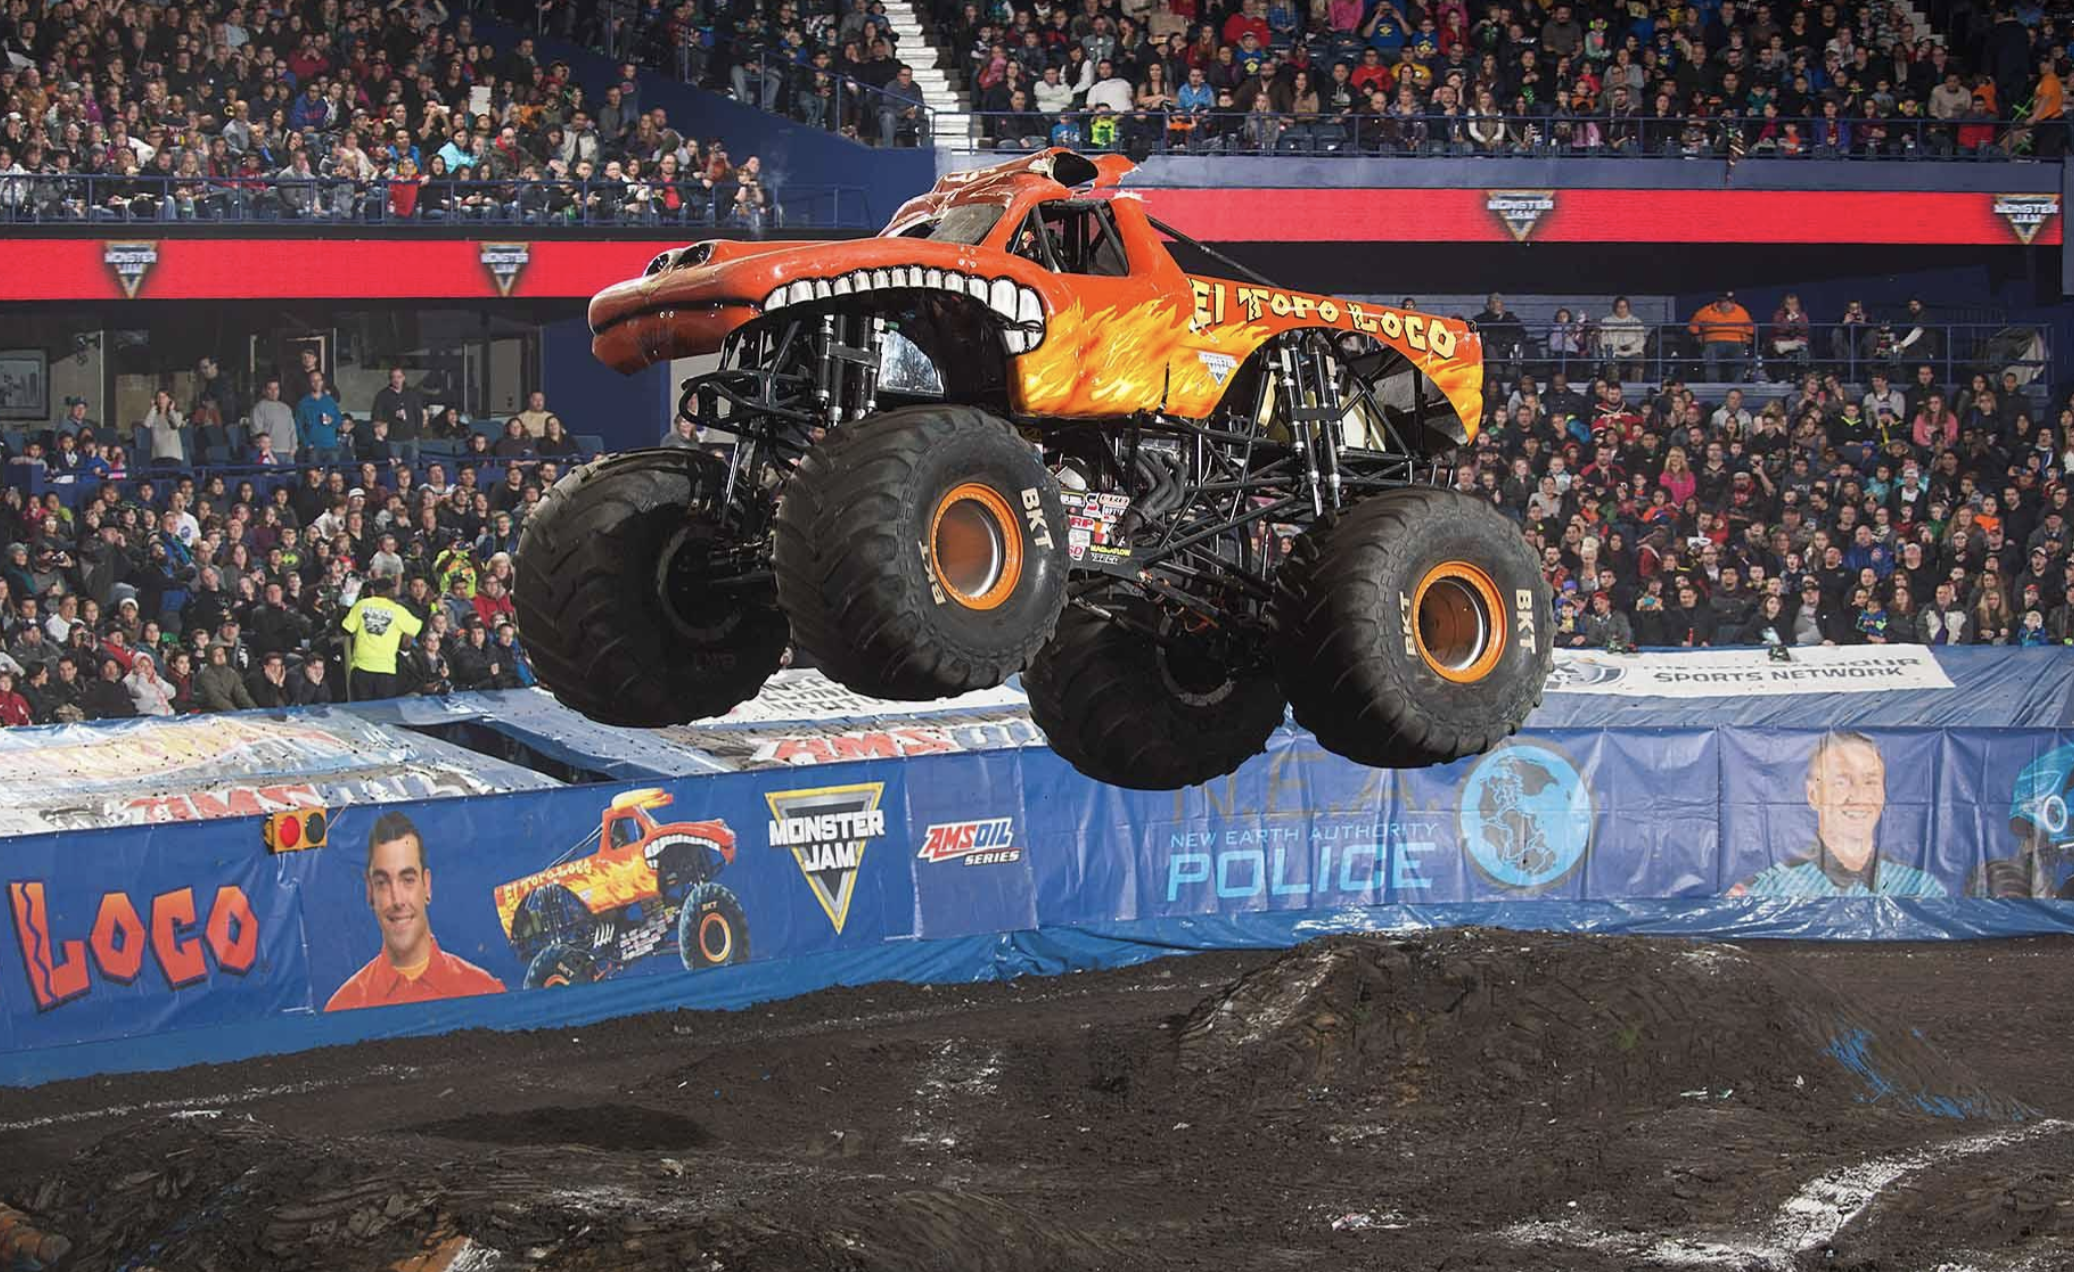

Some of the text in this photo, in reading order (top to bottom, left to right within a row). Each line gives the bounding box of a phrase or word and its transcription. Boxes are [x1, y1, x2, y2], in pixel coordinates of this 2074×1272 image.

[1020, 486, 1055, 550] BKT
[1515, 588, 1537, 655] BKT
[1653, 667, 1903, 683] SPORTS NETWORK
[769, 810, 885, 846] MONSTER
[921, 819, 1013, 860] AMSOIL
[1170, 822, 1439, 848] NEW EARTH AUTHORITY
[805, 841, 857, 872] JAM
[964, 850, 1020, 866] SERIES
[1167, 842, 1436, 902] POLICE
